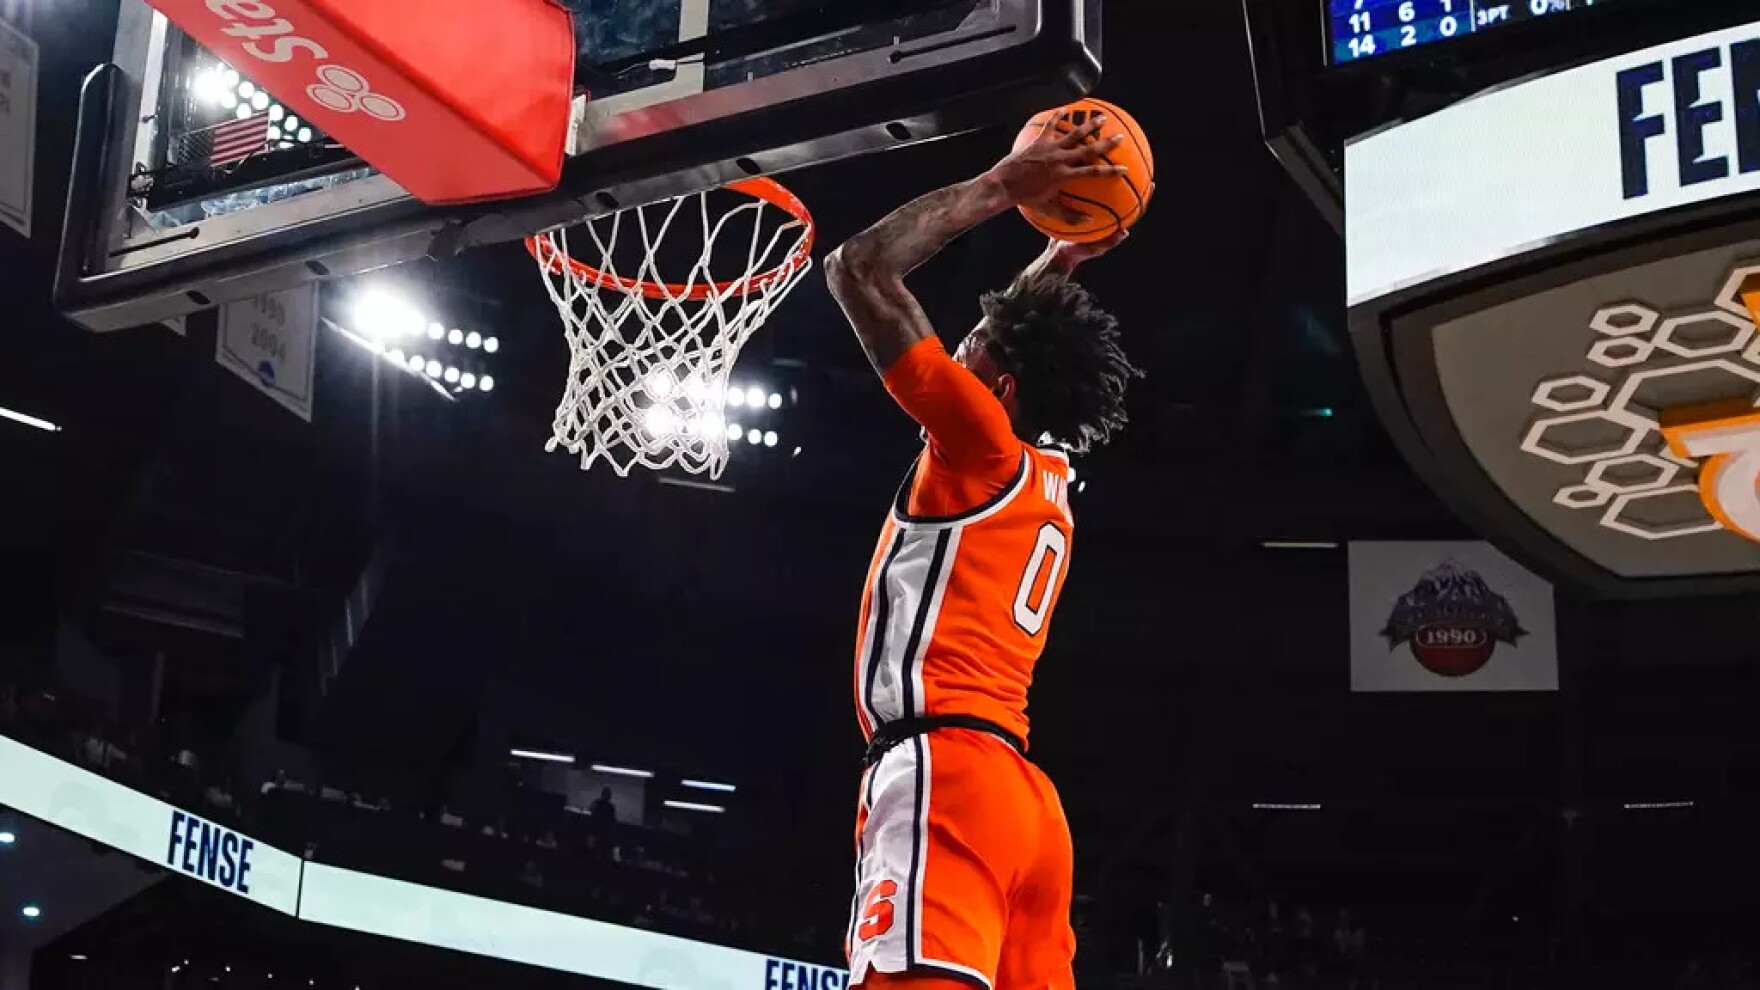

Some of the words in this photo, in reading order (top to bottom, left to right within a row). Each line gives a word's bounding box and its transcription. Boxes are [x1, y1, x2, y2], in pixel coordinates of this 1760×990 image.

[205, 0, 328, 62] Sta
[1348, 11, 1371, 34] 11
[1399, 1, 1415, 22] 6
[1348, 34, 1376, 58] 14
[1400, 25, 1416, 47] 2
[1440, 16, 1456, 36] 0
[1013, 521, 1066, 637] 0
[1427, 629, 1476, 644] 1990
[167, 810, 253, 894] FENSE
[858, 879, 898, 942] S
